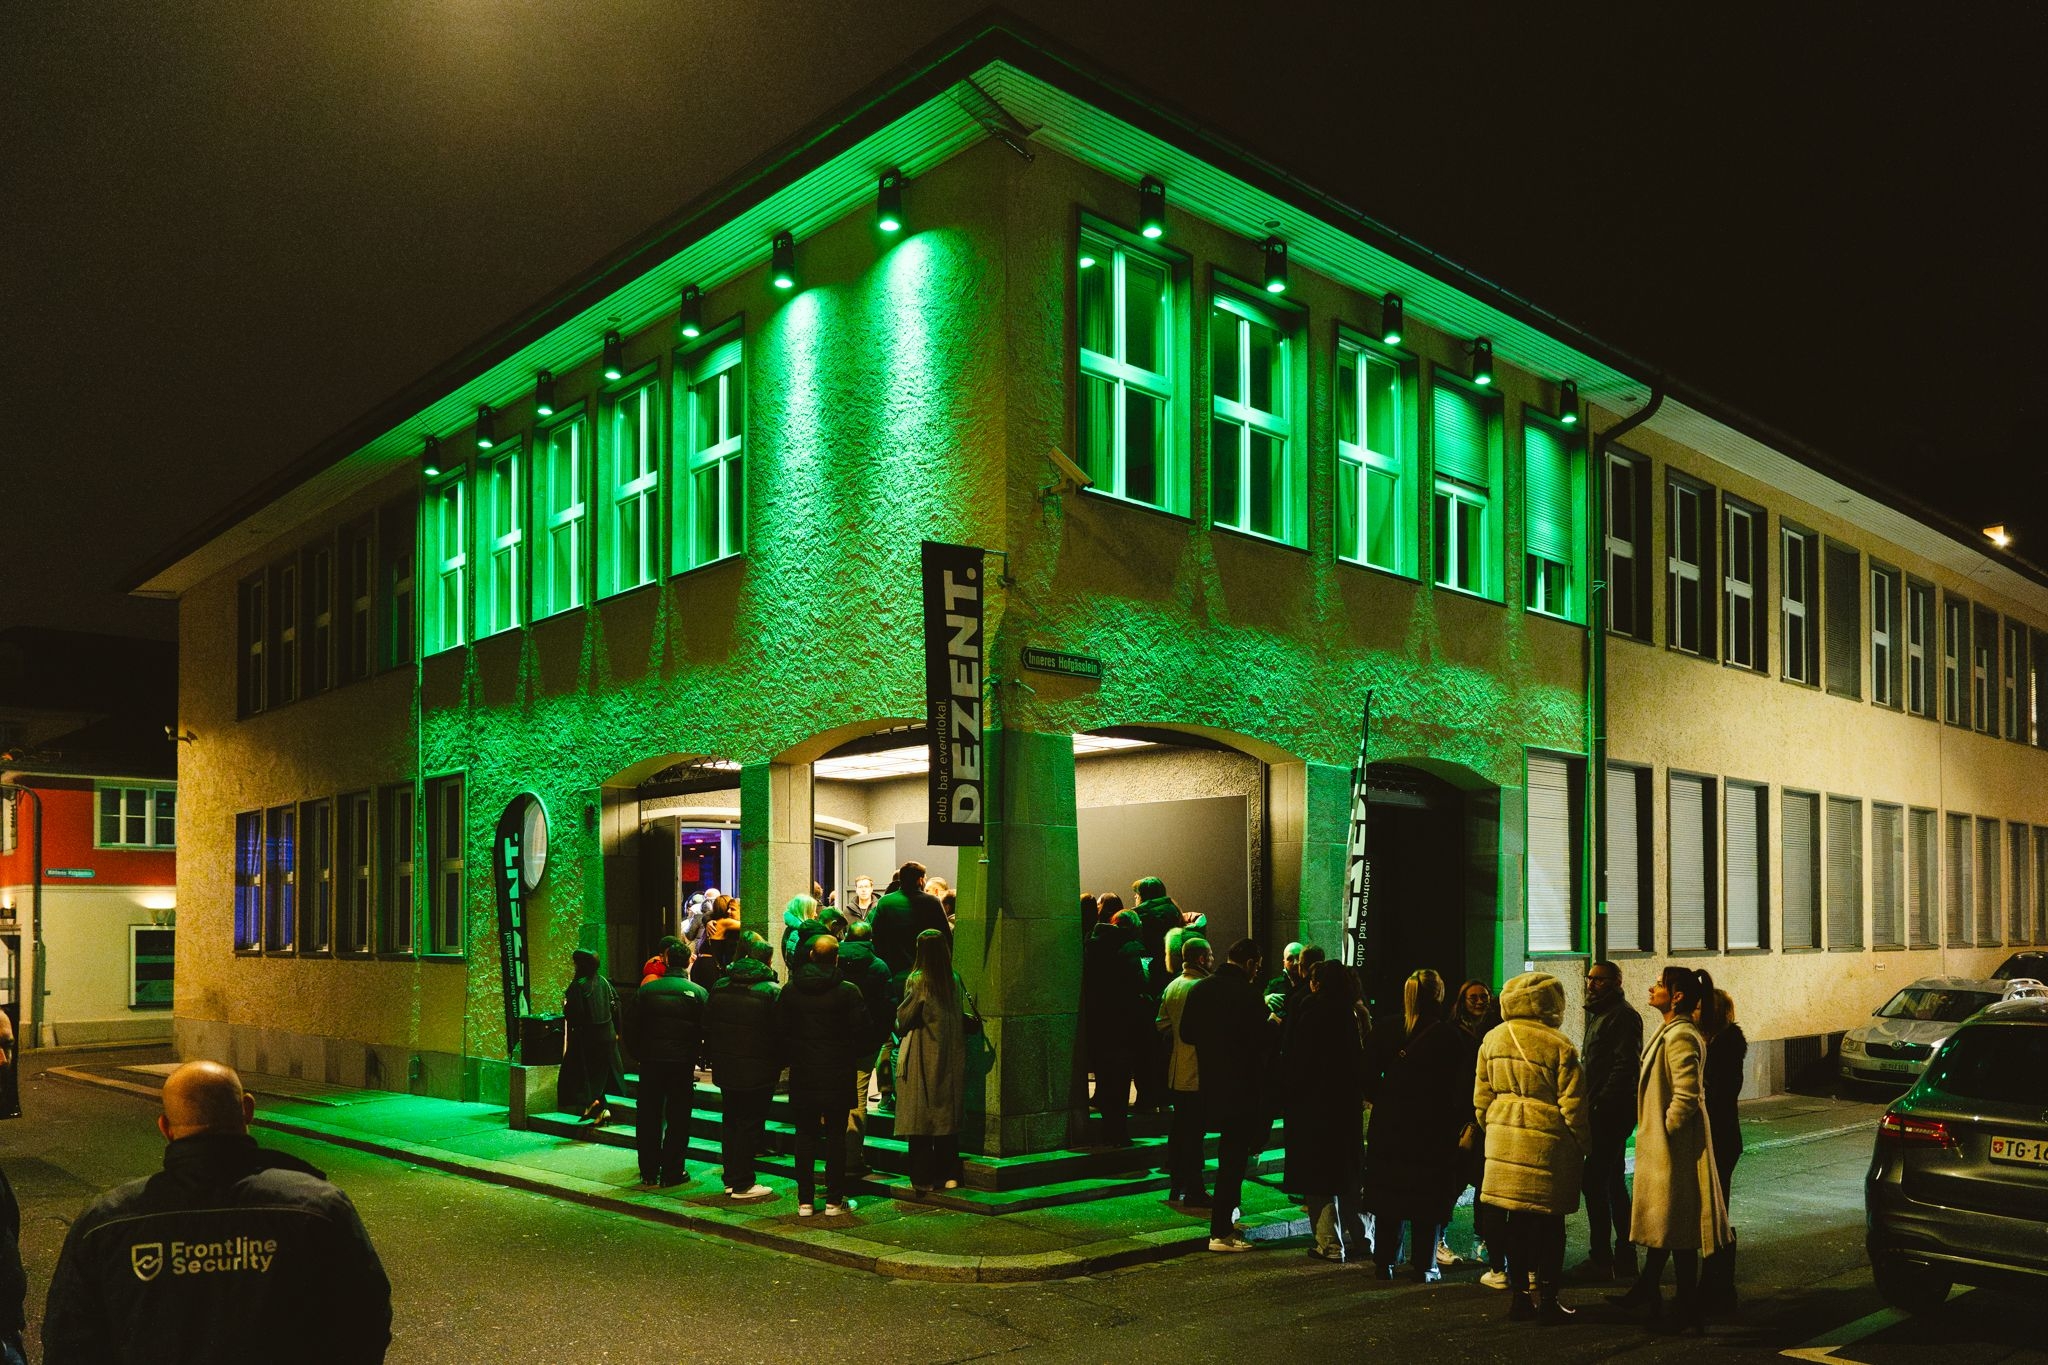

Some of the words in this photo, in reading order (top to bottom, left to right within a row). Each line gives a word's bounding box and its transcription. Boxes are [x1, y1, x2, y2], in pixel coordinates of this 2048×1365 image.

[1028, 651, 1056, 668] Inneres
[1058, 656, 1098, 674] Hofgässlein
[943, 567, 981, 824] DEZENT.
[936, 698, 948, 765] eventlokal.
[937, 768, 949, 791] bar.
[936, 793, 948, 824] club.
[171, 1236, 278, 1259] Frontline
[172, 1252, 273, 1275] Security
